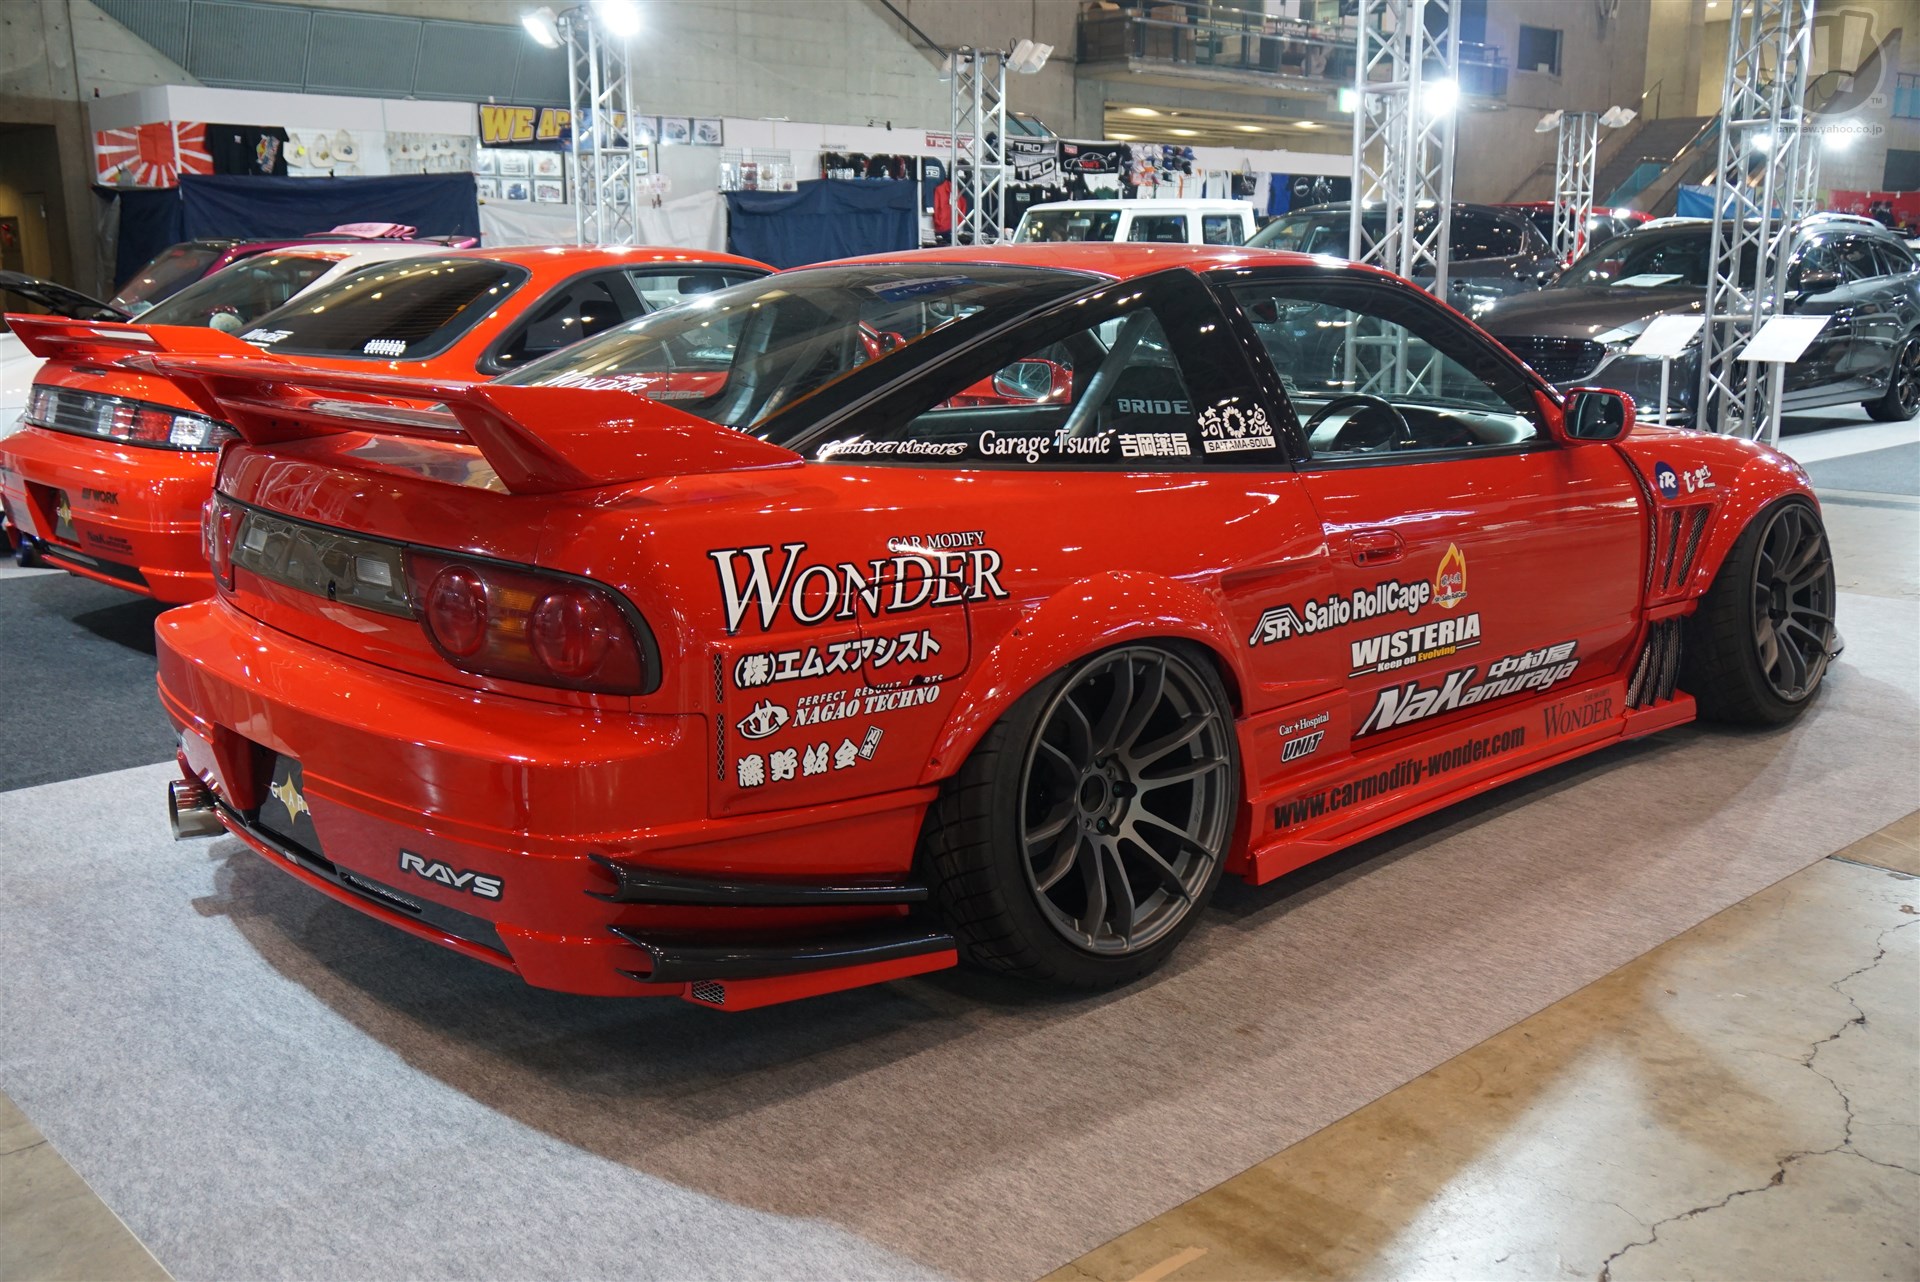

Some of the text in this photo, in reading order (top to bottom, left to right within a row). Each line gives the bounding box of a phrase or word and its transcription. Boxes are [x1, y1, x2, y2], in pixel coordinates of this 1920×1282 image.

[480, 105, 535, 143] WE
[1015, 142, 1041, 152] TRD
[1017, 158, 1056, 180] TRD
[1117, 398, 1191, 415] BRIDE
[897, 438, 969, 456] Motors
[977, 430, 1051, 463] Garage
[1117, 432, 1192, 457] 吉岡薬局
[92, 489, 119, 505] WORK
[887, 531, 985, 552] CAR MODIFY
[710, 543, 1008, 634] WONDER
[1303, 578, 1431, 634] Saito RollCage
[1350, 612, 1481, 669] WISTERIA
[734, 630, 941, 688] (株)エムズアシスト
[1377, 645, 1456, 672] Keep on Evolving
[1487, 640, 1578, 679] 中村屋
[792, 685, 941, 728] NAGAO TECHNO
[797, 690, 847, 708] PERFECT
[1279, 711, 1330, 736] Car Hospital
[1543, 697, 1614, 739] WONDER
[1281, 730, 1325, 763] UNIT
[1273, 724, 1526, 830] www.carmodify-wonder.com
[400, 851, 502, 898] RAYS
